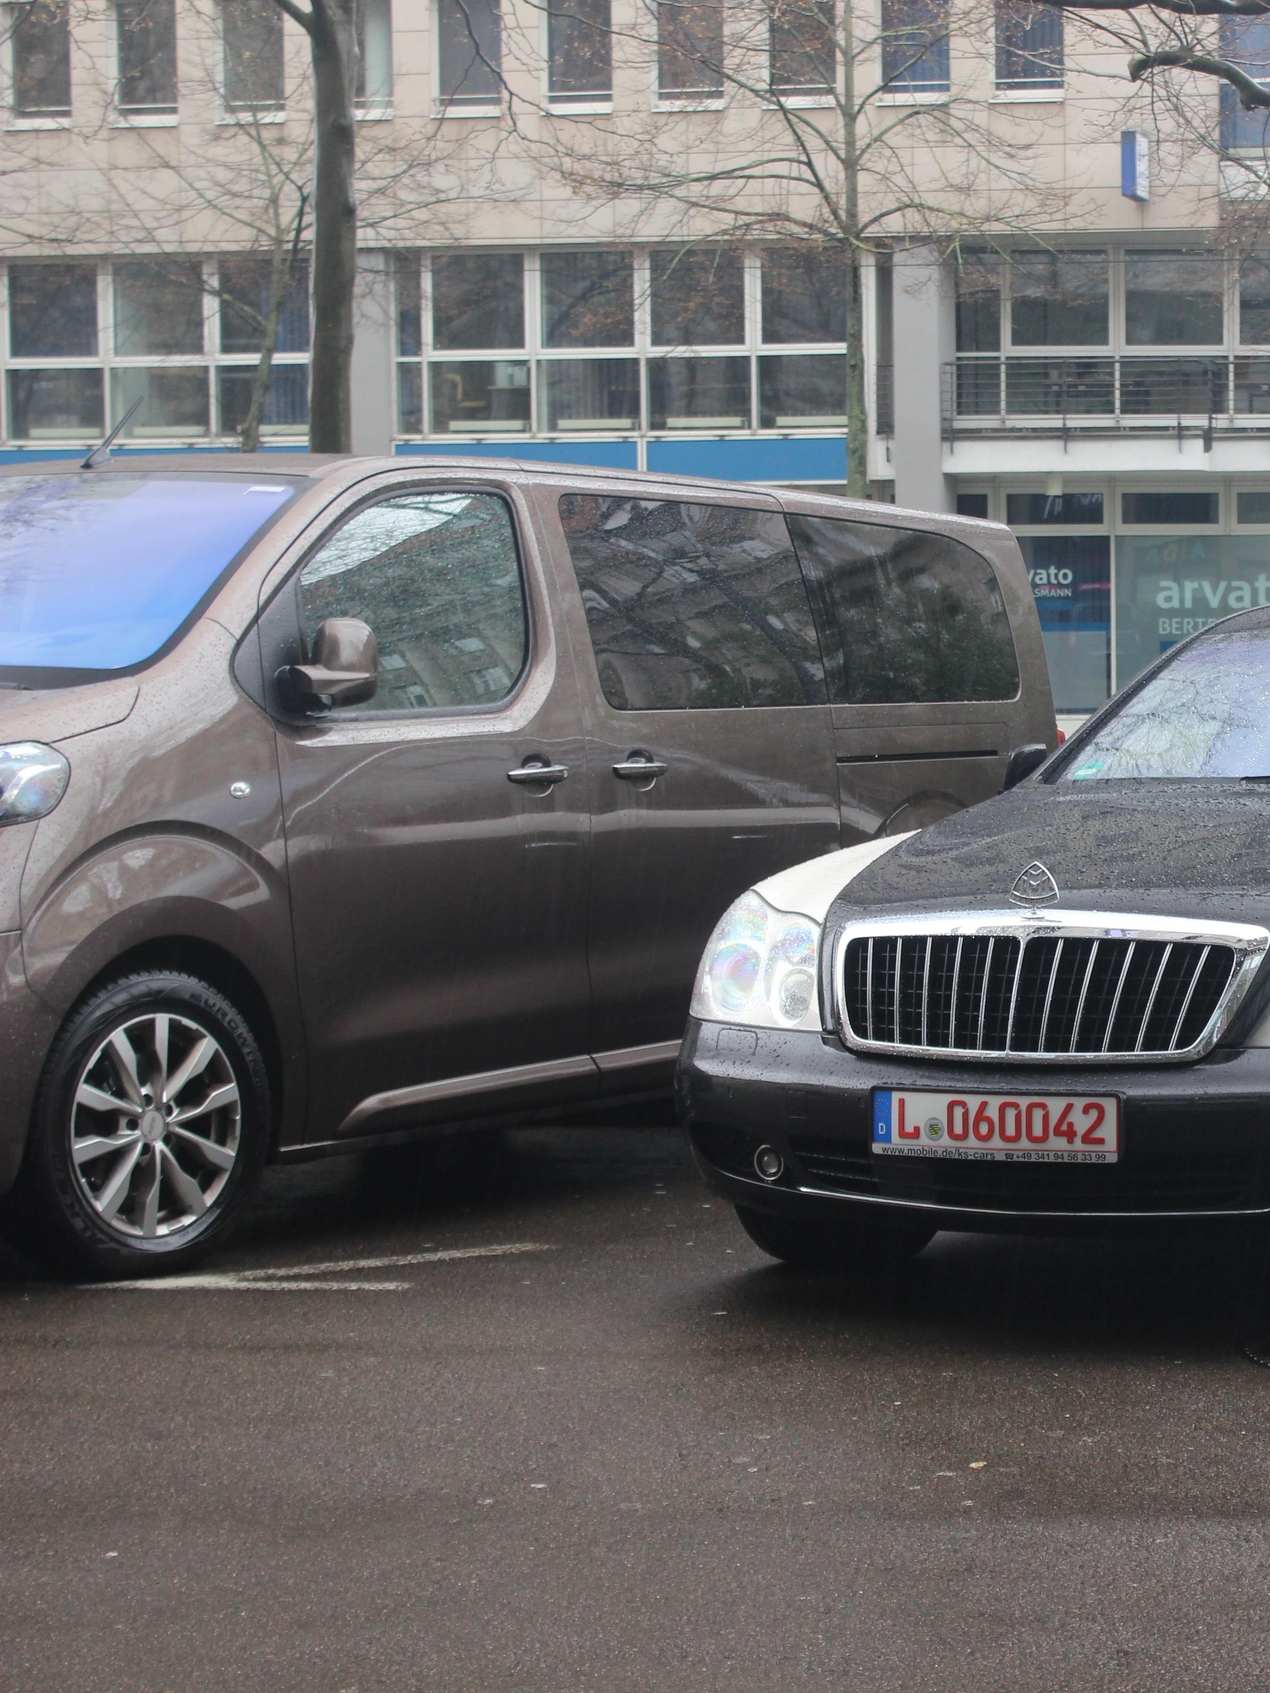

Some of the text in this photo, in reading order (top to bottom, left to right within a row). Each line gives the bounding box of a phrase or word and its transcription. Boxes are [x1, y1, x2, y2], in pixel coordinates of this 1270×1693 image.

[878, 1122, 886, 1135] D
[898, 1097, 1106, 1145] L 060042
[882, 1146, 1107, 1162] www.mobile.de/ks-cars +49 341 94 56 33 99
